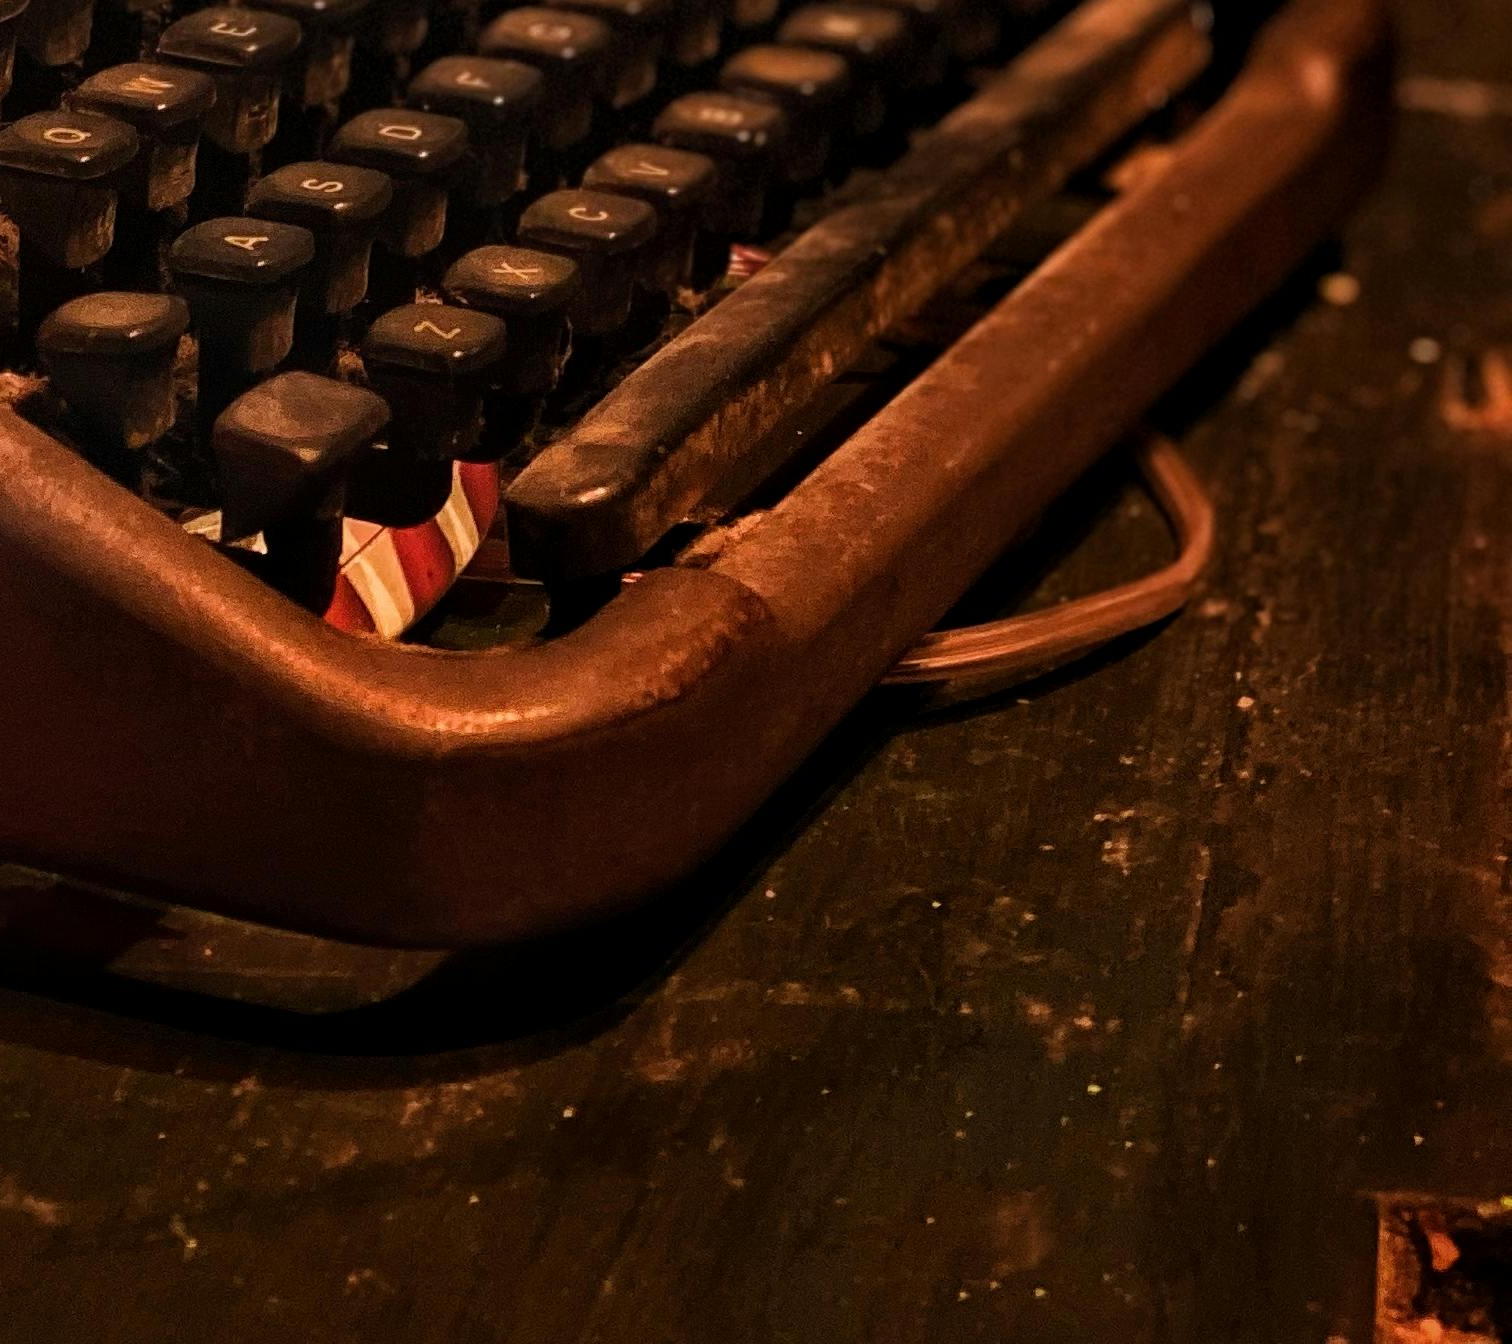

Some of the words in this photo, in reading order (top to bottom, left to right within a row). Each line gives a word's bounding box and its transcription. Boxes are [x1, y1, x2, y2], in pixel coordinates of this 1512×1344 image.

[209, 21, 257, 38] E
[42, 126, 92, 144] Q
[377, 124, 423, 141] D
[626, 161, 670, 177] V
[299, 178, 344, 194] S
[568, 206, 609, 222] C
[223, 234, 270, 251] A
[492, 261, 542, 281] X
[413, 318, 462, 340] Z
